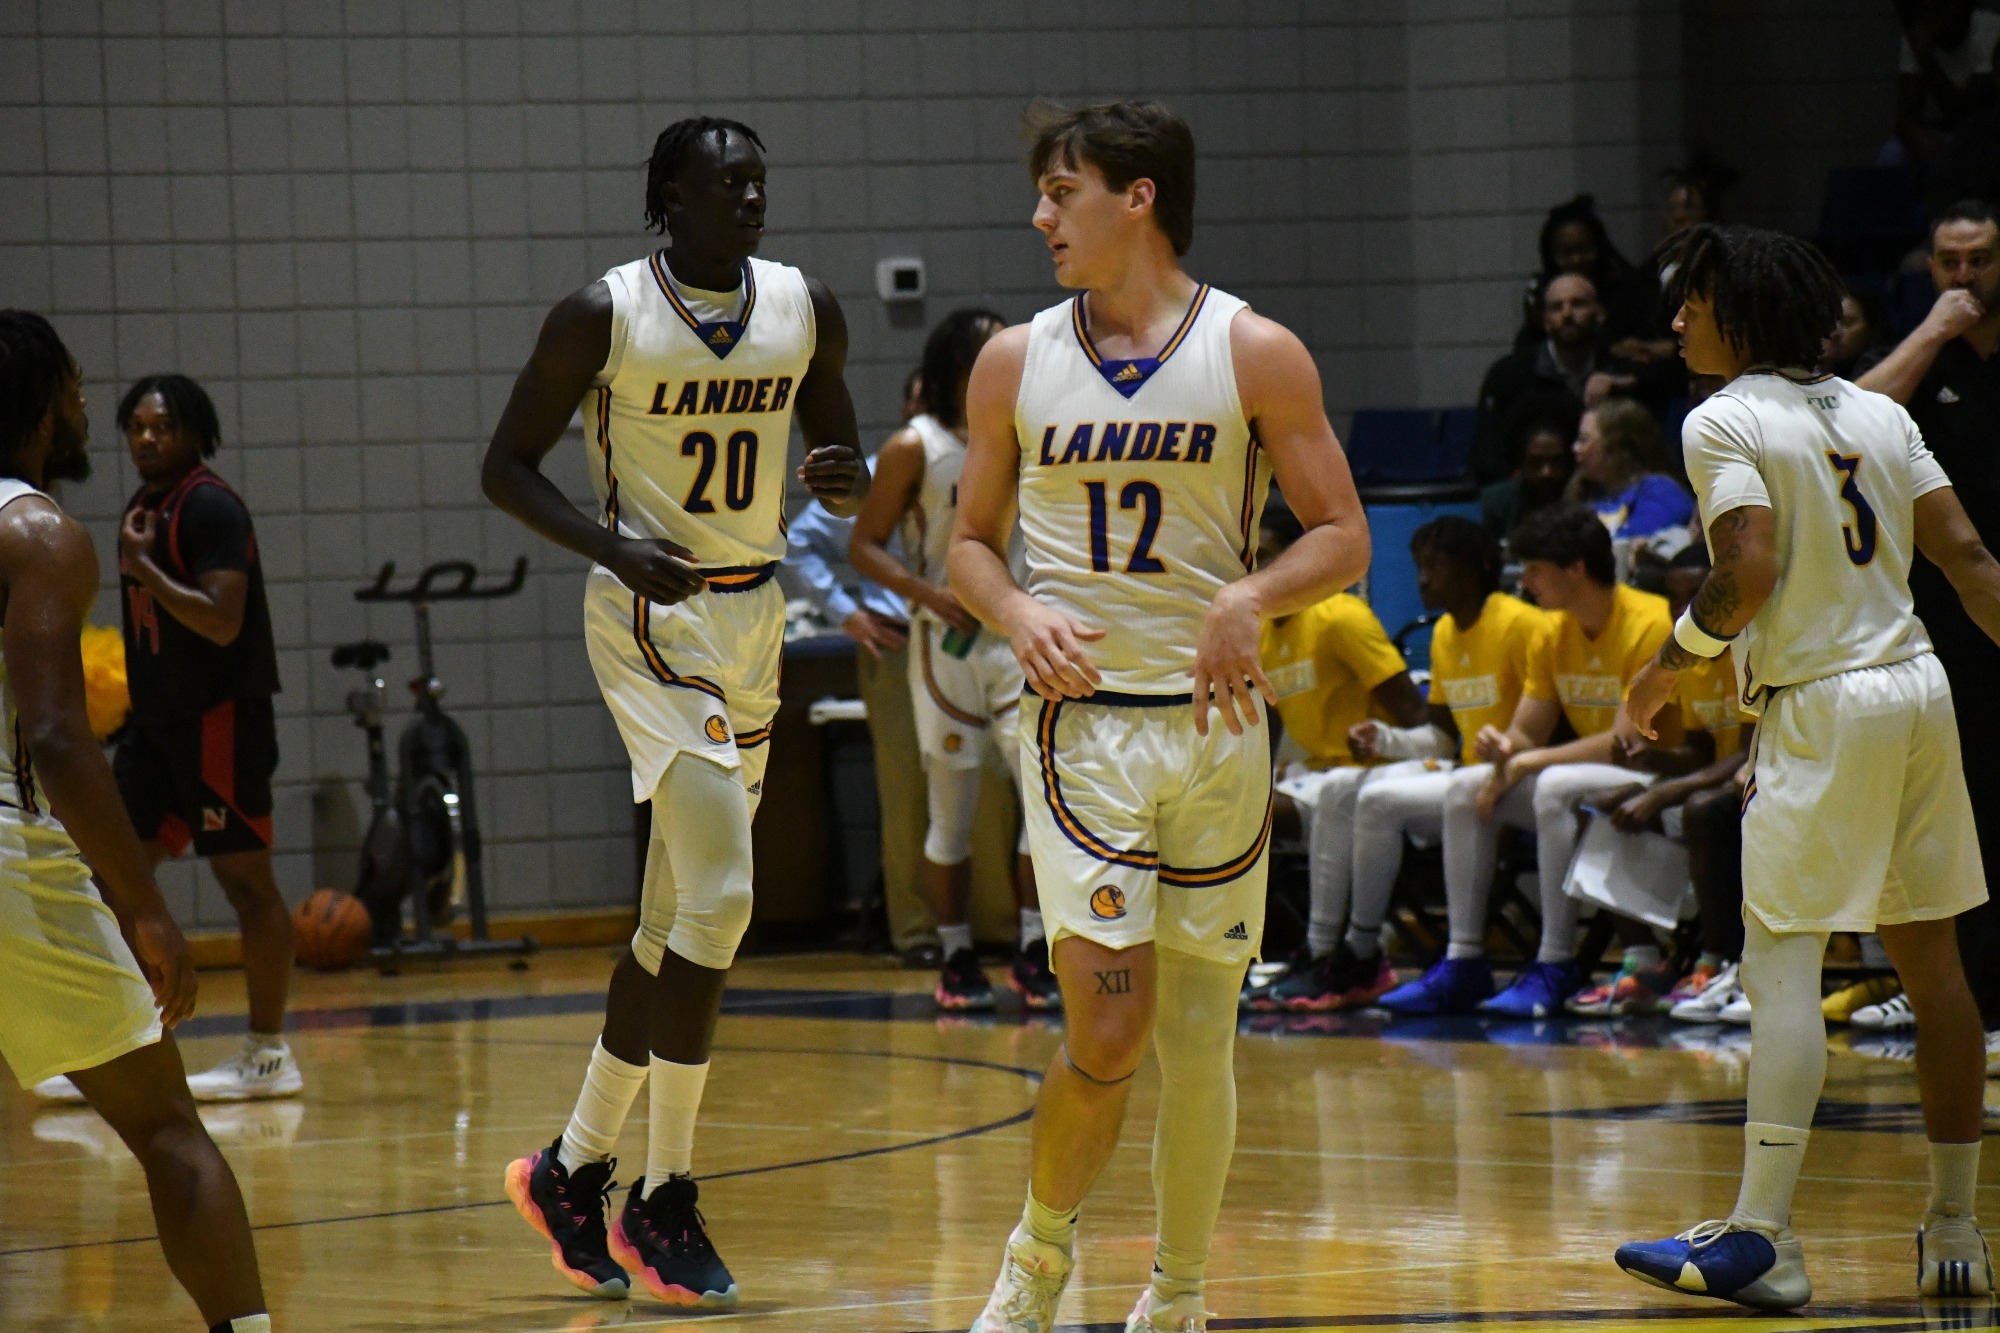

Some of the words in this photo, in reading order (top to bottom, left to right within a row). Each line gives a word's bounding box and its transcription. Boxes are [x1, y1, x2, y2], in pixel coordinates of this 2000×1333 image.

[646, 375, 793, 416] LANDER
[1038, 421, 1217, 466] LANDER
[679, 427, 760, 514] 20
[1078, 478, 1168, 574] 12
[1825, 450, 1880, 568] 3
[1224, 932, 1248, 940] adidas
[1093, 968, 1132, 994] XII
